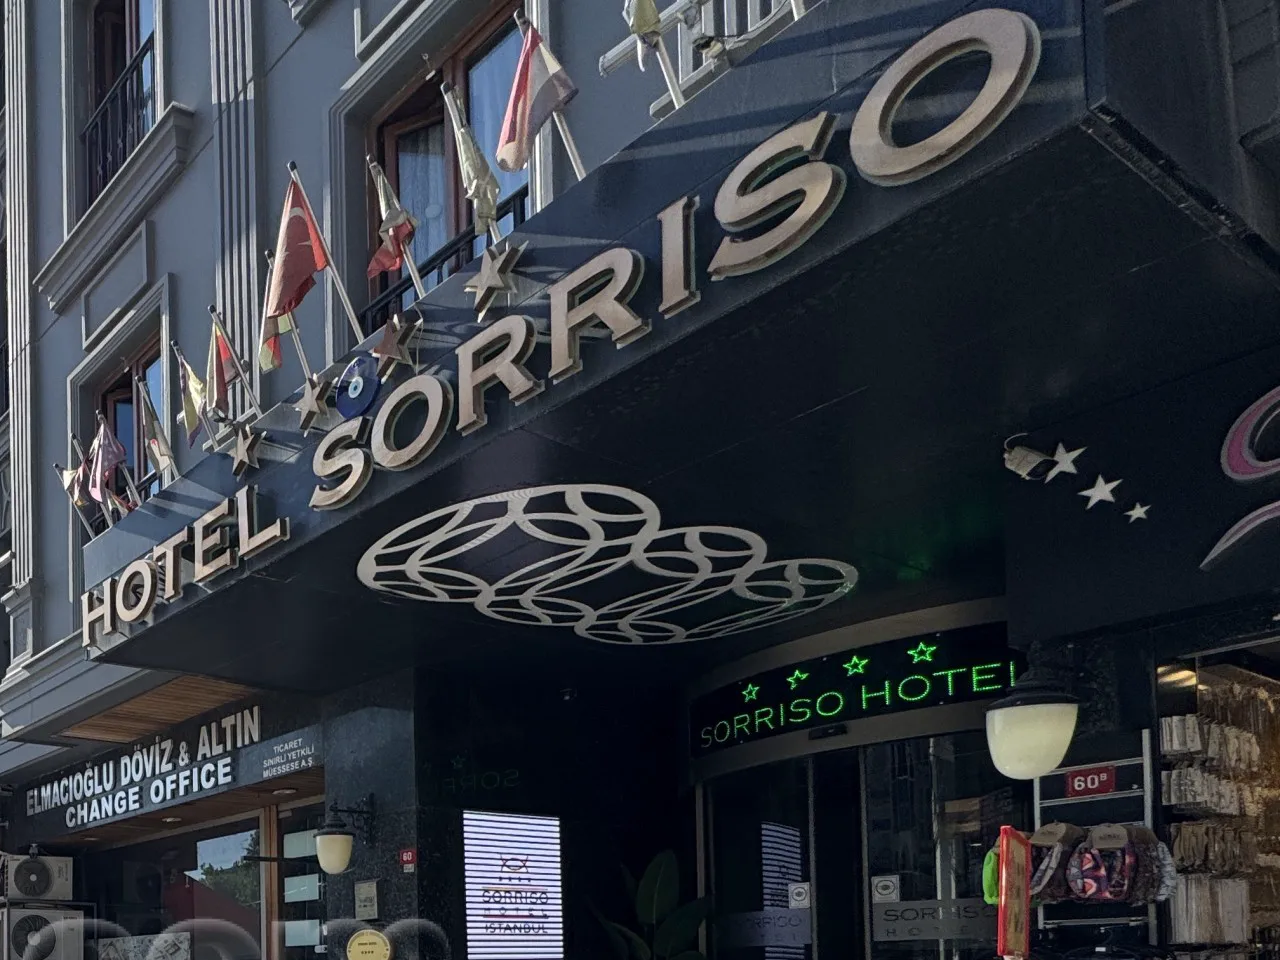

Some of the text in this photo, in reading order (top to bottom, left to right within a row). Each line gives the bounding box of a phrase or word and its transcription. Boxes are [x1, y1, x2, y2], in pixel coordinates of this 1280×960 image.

[81, 7, 1041, 648] HOTEL SORRISO
[701, 691, 844, 748] SORRISO
[26, 705, 261, 817] ELMACIOĞLU DÖVİZ & ALTIN
[65, 757, 232, 828] CHANGE OFFICE
[403, 852, 412, 861] 60
[482, 890, 549, 905] SORRISO
